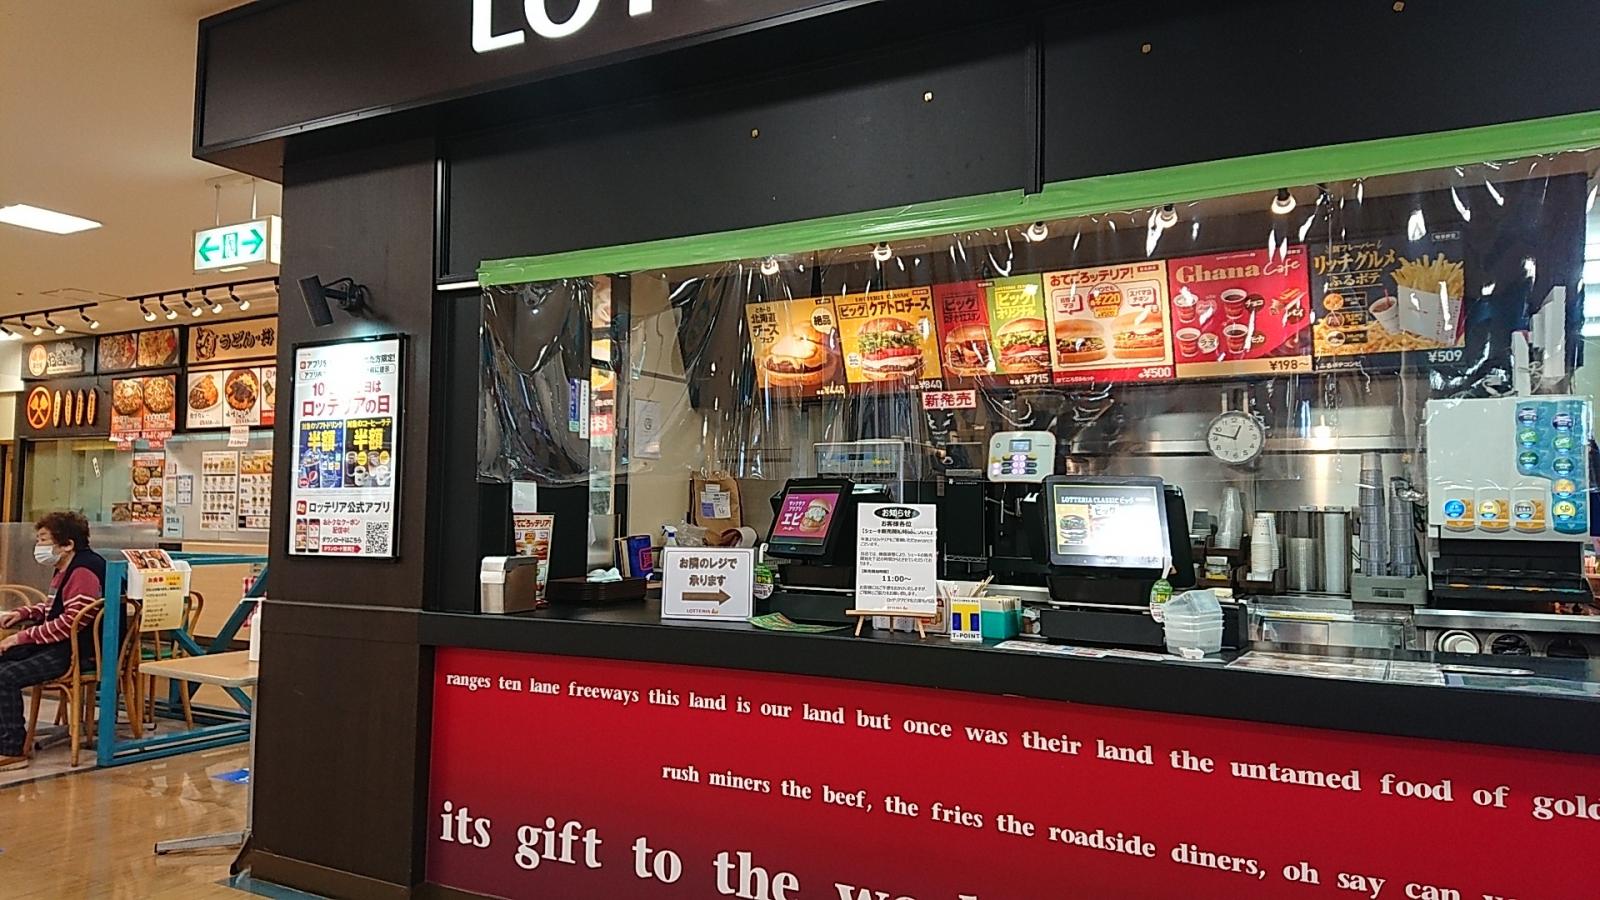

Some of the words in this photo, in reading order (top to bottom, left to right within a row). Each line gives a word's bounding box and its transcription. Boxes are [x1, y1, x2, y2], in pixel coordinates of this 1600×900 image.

[1314, 249, 1396, 275] リッチグルメ
[1050, 267, 1134, 286] おてごろッテリア!
[1175, 264, 1260, 284] Ghana
[1329, 272, 1381, 287] ふるポテ
[840, 305, 865, 317] ビッグ
[869, 296, 930, 316] クアトロチーズ
[944, 296, 976, 311] ビッグ
[813, 314, 831, 326] 絶品
[1427, 349, 1463, 362] ¥509
[1024, 374, 1049, 384] ¥715
[1143, 367, 1171, 379] ¥500
[924, 392, 972, 407] 新発売
[307, 429, 336, 453] 半額
[353, 427, 384, 451] 半額
[309, 501, 390, 514] ロッテリア公式アプリ
[1093, 496, 1120, 504] CLASSIC
[781, 512, 804, 526] エビ
[881, 508, 912, 518] お知らせ
[881, 520, 912, 528] お客様各位
[679, 556, 738, 569] お隣のレジで
[688, 574, 727, 587] 承ります
[446, 673, 491, 691] ranges
[498, 676, 522, 691] ten
[529, 677, 560, 695] lane
[568, 681, 639, 706] freeways
[648, 688, 680, 706] this
[689, 692, 727, 711] land
[736, 696, 751, 714] is
[760, 703, 793, 718] our
[803, 703, 845, 724] land
[856, 709, 891, 730] but
[903, 719, 952, 738] once
[964, 727, 1008, 745] was
[1021, 731, 1082, 755] their
[1096, 739, 1154, 765] land
[1169, 750, 1214, 773] the
[1230, 762, 1362, 791] untamed
[1379, 773, 1454, 802] food
[1472, 785, 1510, 808] of
[662, 765, 700, 783] rush
[709, 770, 771, 793] miners
[780, 779, 812, 800] the
[822, 785, 872, 813] beef,
[884, 796, 919, 817] the
[931, 802, 983, 828] fries
[996, 814, 1035, 837] the
[1048, 827, 1156, 858] roadside
[1171, 843, 1266, 880] diners,
[1283, 861, 1320, 885] oh
[1337, 872, 1386, 900] say
[1405, 883, 1461, 900] can
[439, 800, 491, 848] its
[514, 817, 603, 870] gift
[631, 837, 682, 883] to
[712, 851, 800, 900] the
